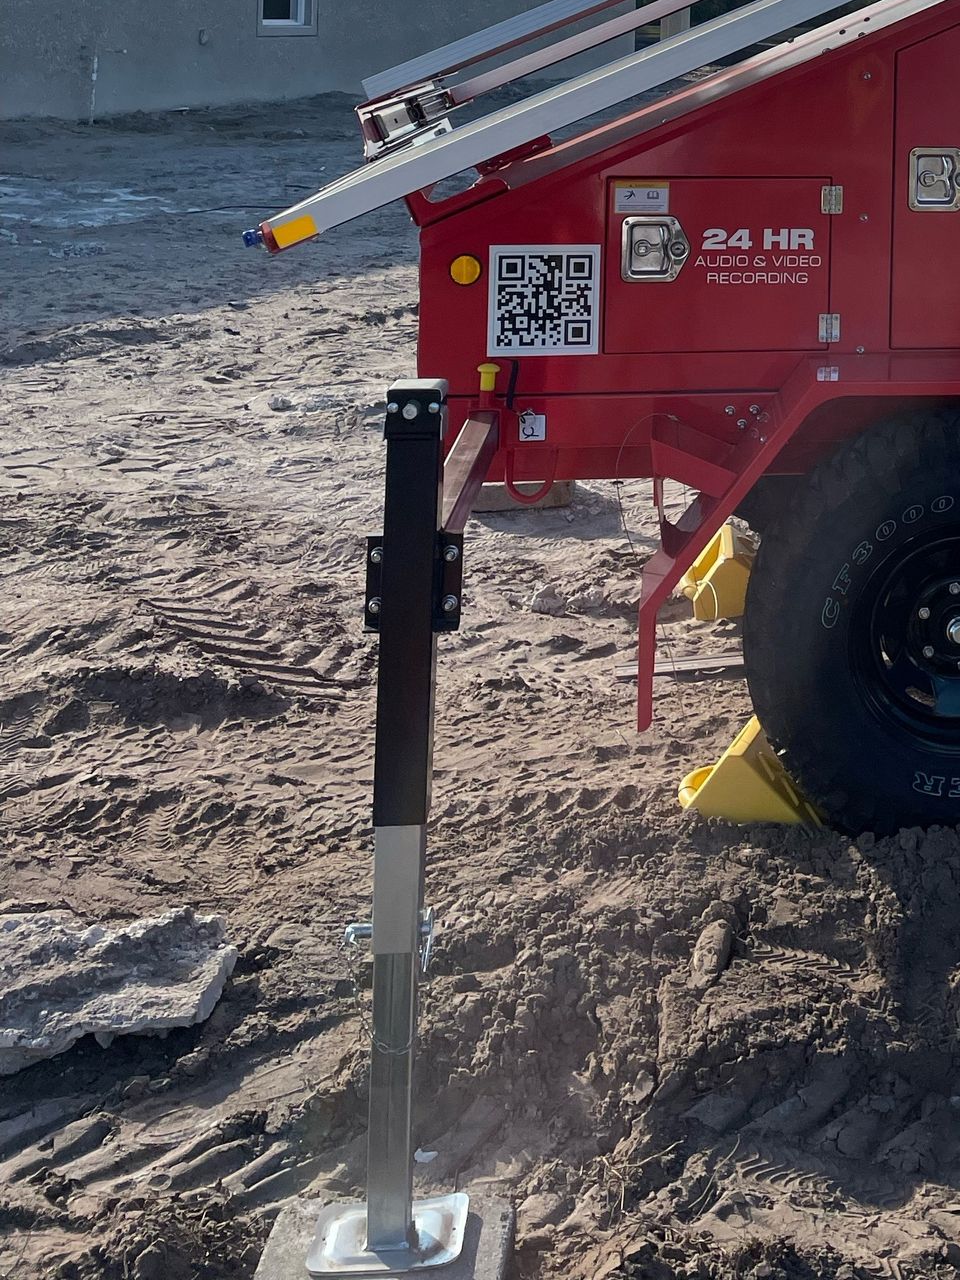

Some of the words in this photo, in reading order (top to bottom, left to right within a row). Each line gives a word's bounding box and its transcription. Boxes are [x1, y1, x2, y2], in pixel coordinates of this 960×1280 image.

[701, 228, 752, 250] 24
[763, 228, 814, 250] HR
[694, 255, 749, 267] AUDIO
[753, 255, 767, 267] &
[772, 255, 821, 267] VIDEO
[706, 272, 809, 284] RECORDING
[821, 495, 954, 629] CF3000
